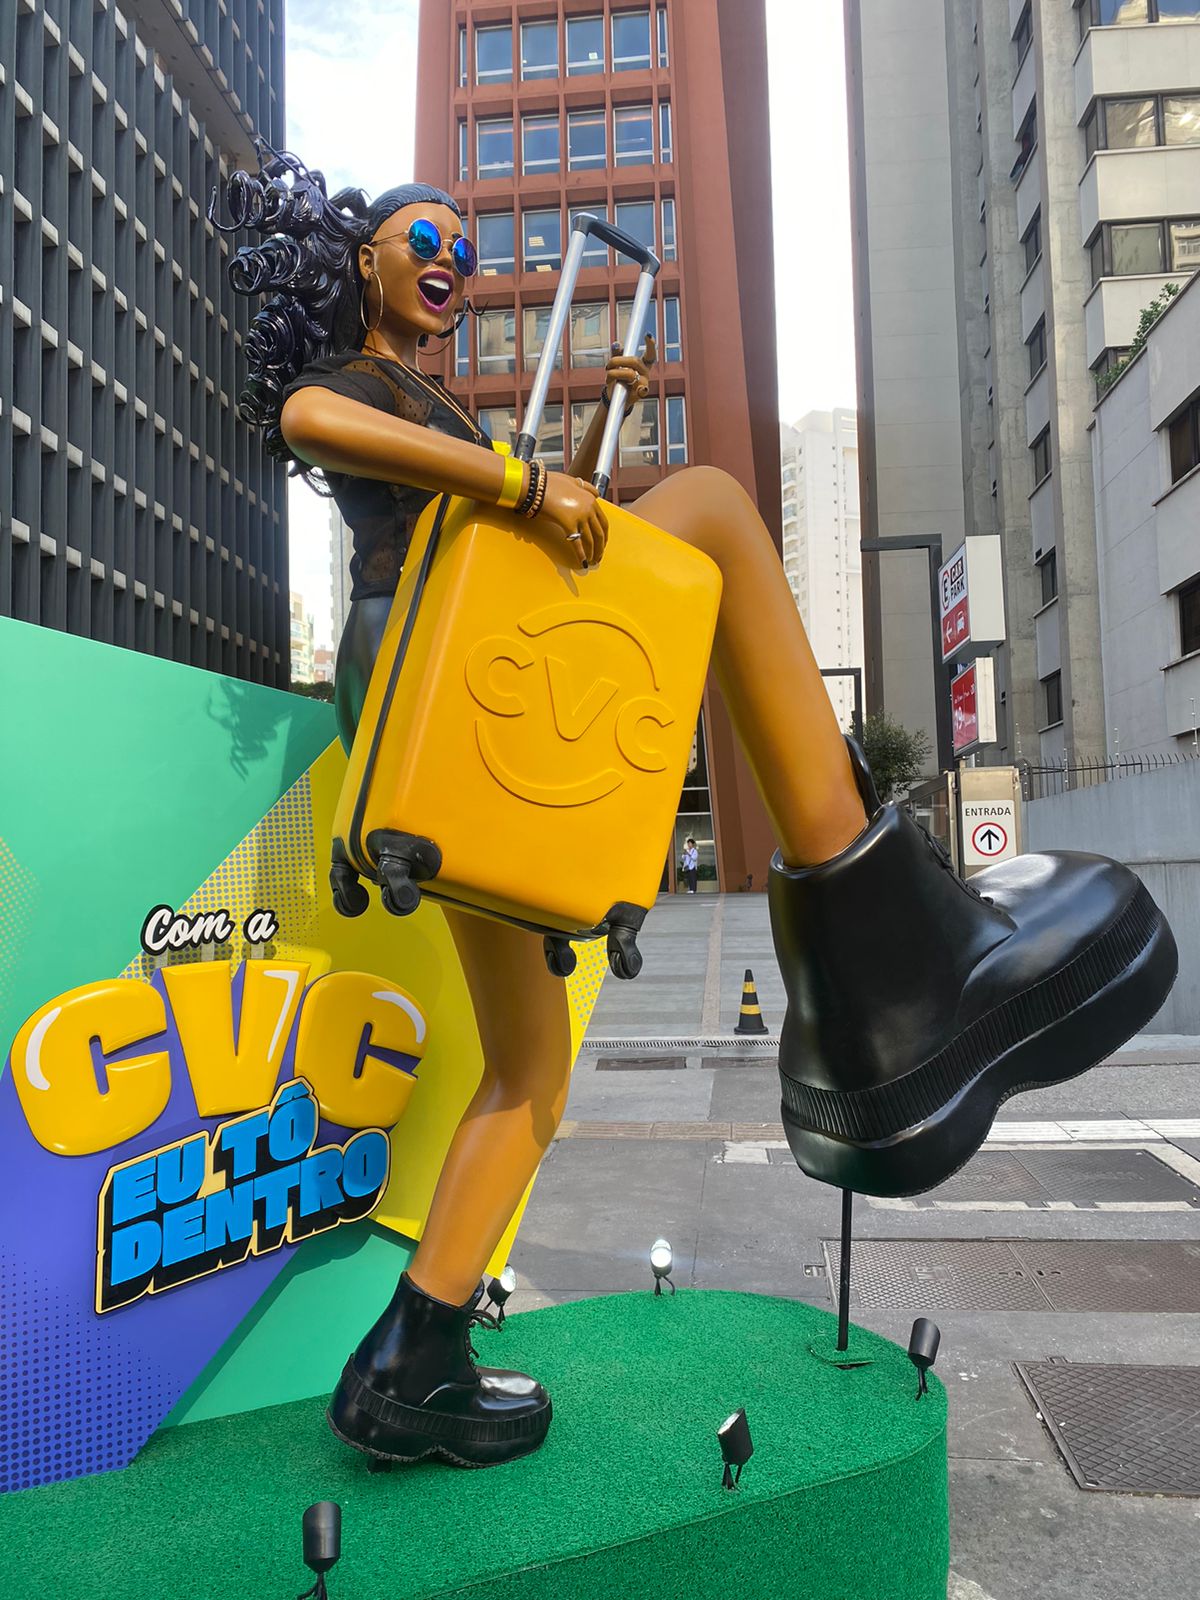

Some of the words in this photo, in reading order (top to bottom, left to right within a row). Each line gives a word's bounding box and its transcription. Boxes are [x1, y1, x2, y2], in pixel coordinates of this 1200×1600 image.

[950, 575, 965, 601] PARK
[951, 559, 964, 583] CAR
[465, 635, 676, 774] CVC
[965, 807, 1012, 816] ENTRADA
[144, 907, 232, 951] Com
[246, 911, 277, 942] a
[10, 959, 430, 1157] CVC
[113, 1136, 206, 1226] EU
[221, 1081, 316, 1179] TÔ
[110, 1132, 389, 1287] DENTRO
